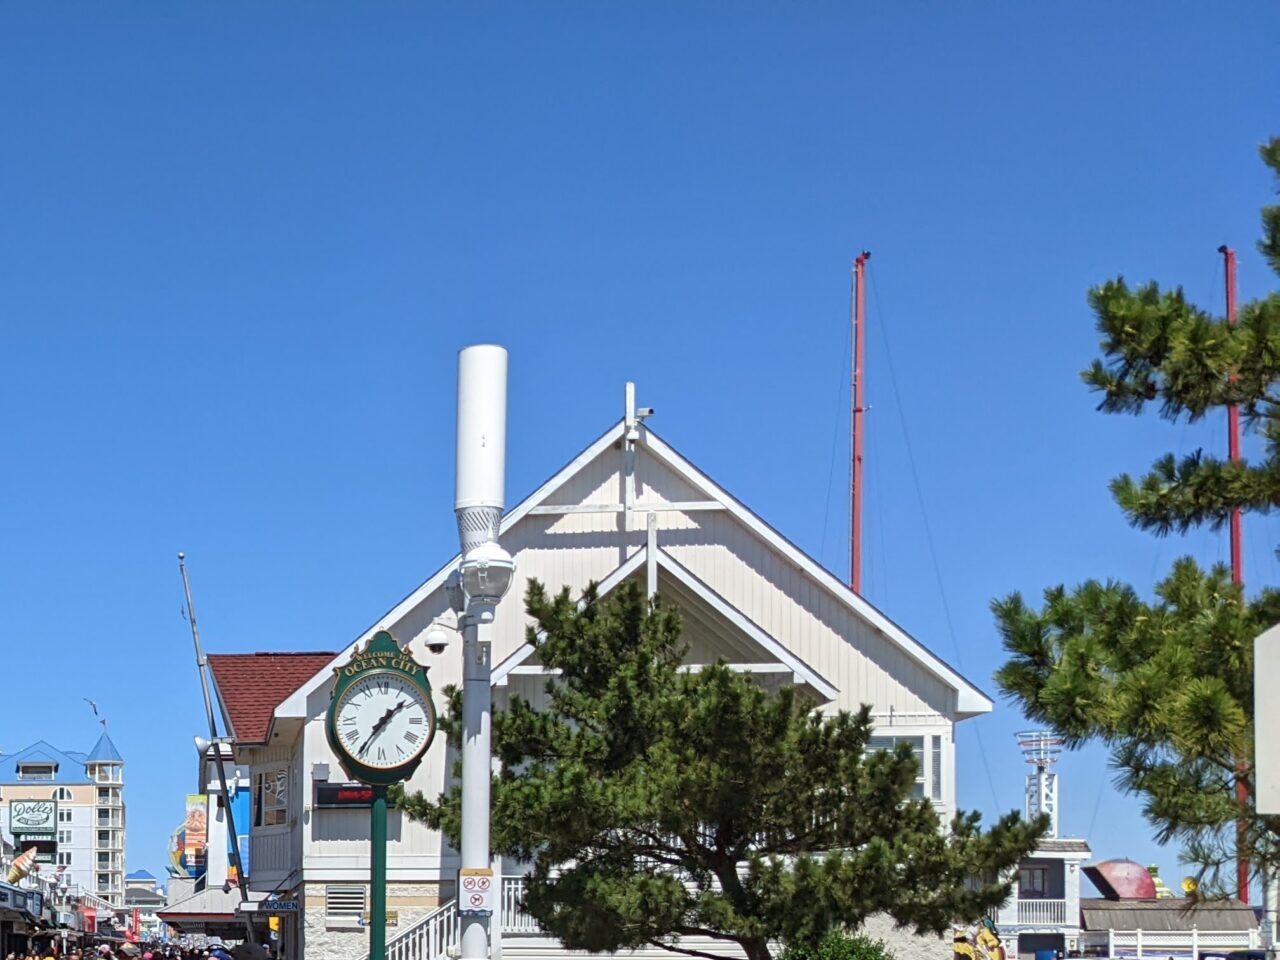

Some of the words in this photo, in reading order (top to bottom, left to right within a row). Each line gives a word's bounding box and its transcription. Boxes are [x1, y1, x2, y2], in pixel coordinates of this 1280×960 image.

[356, 650, 395, 661] WELCOME
[344, 657, 387, 676] OCEAN
[391, 658, 420, 676] CITY
[265, 901, 298, 910] WOMEN
